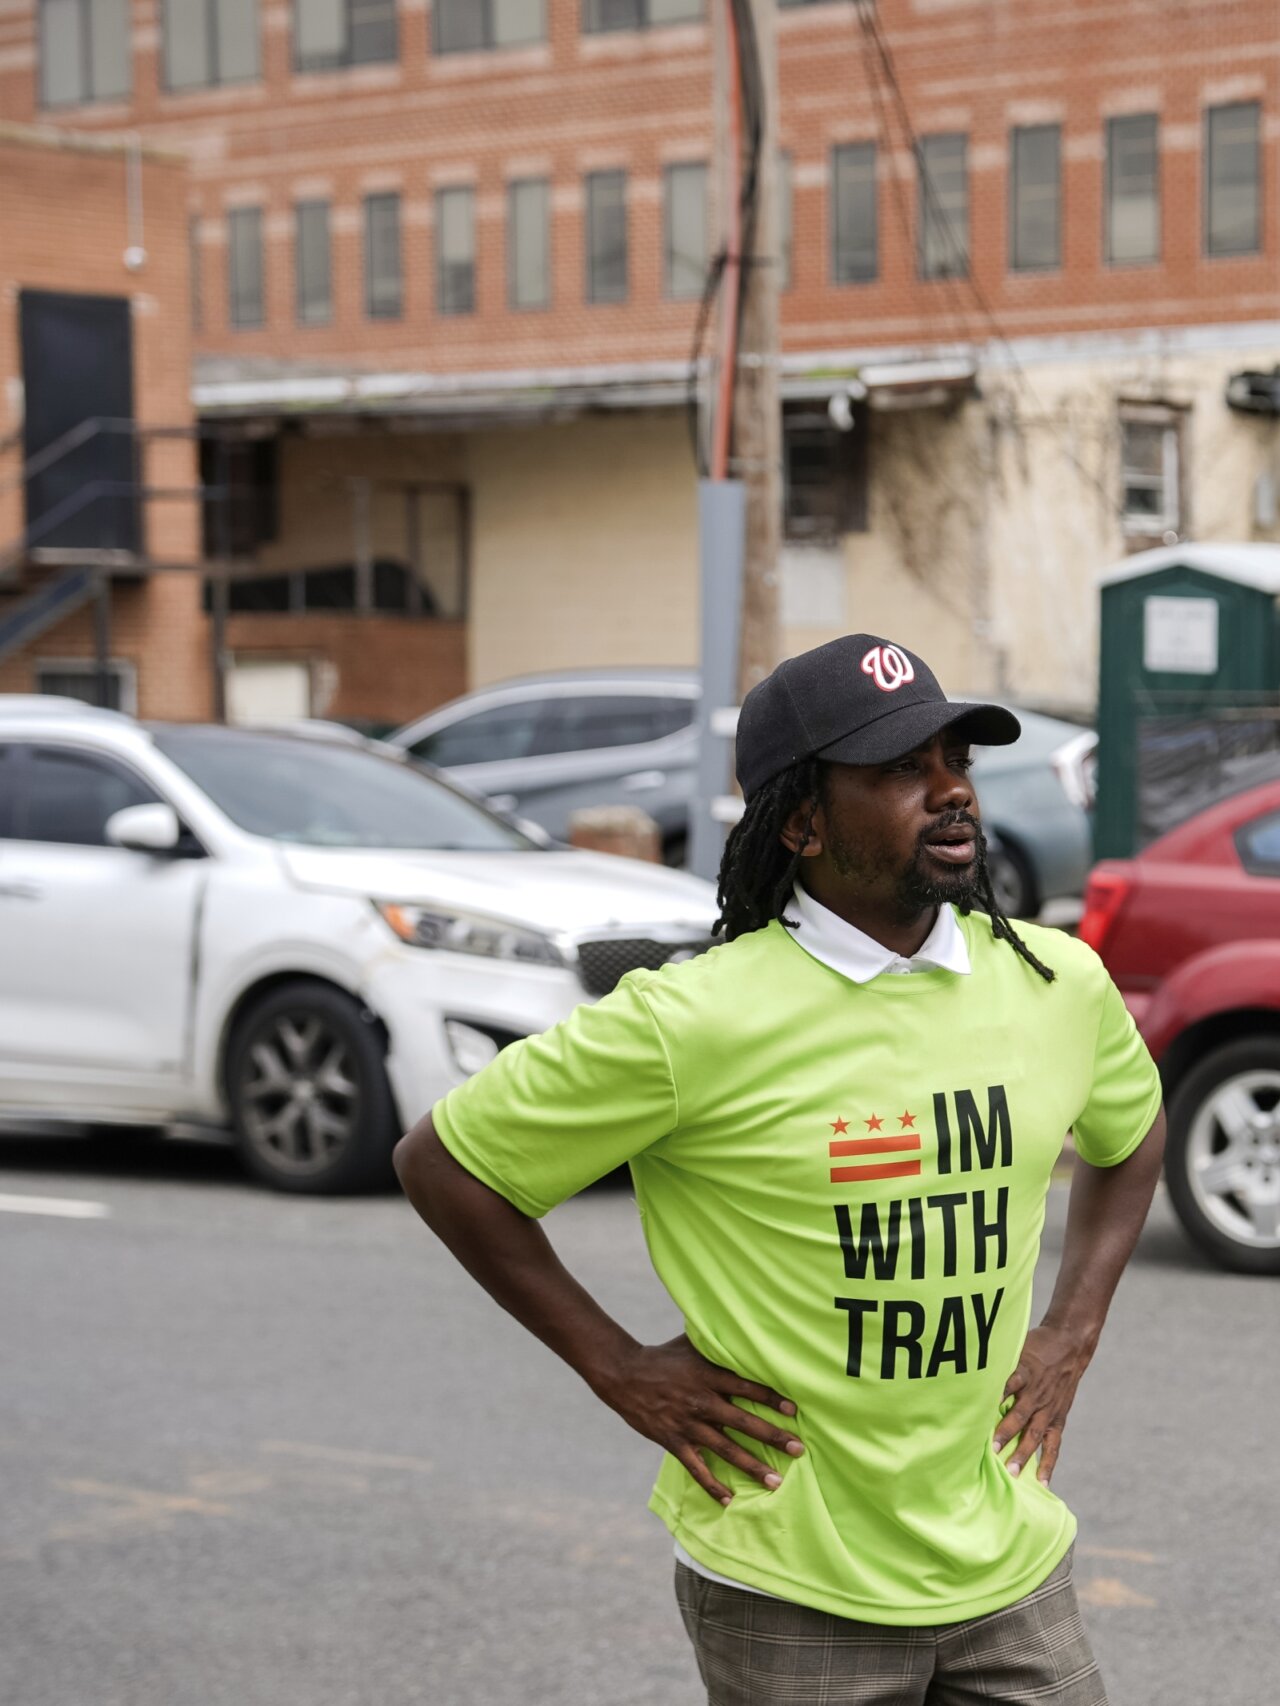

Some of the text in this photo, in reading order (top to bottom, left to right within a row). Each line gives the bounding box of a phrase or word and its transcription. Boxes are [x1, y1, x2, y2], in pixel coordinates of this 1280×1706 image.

[861, 645, 915, 692] W
[932, 1084, 1013, 1175] IM
[833, 1186, 1009, 1281] WITH
[834, 1287, 1005, 1380] TRAY
